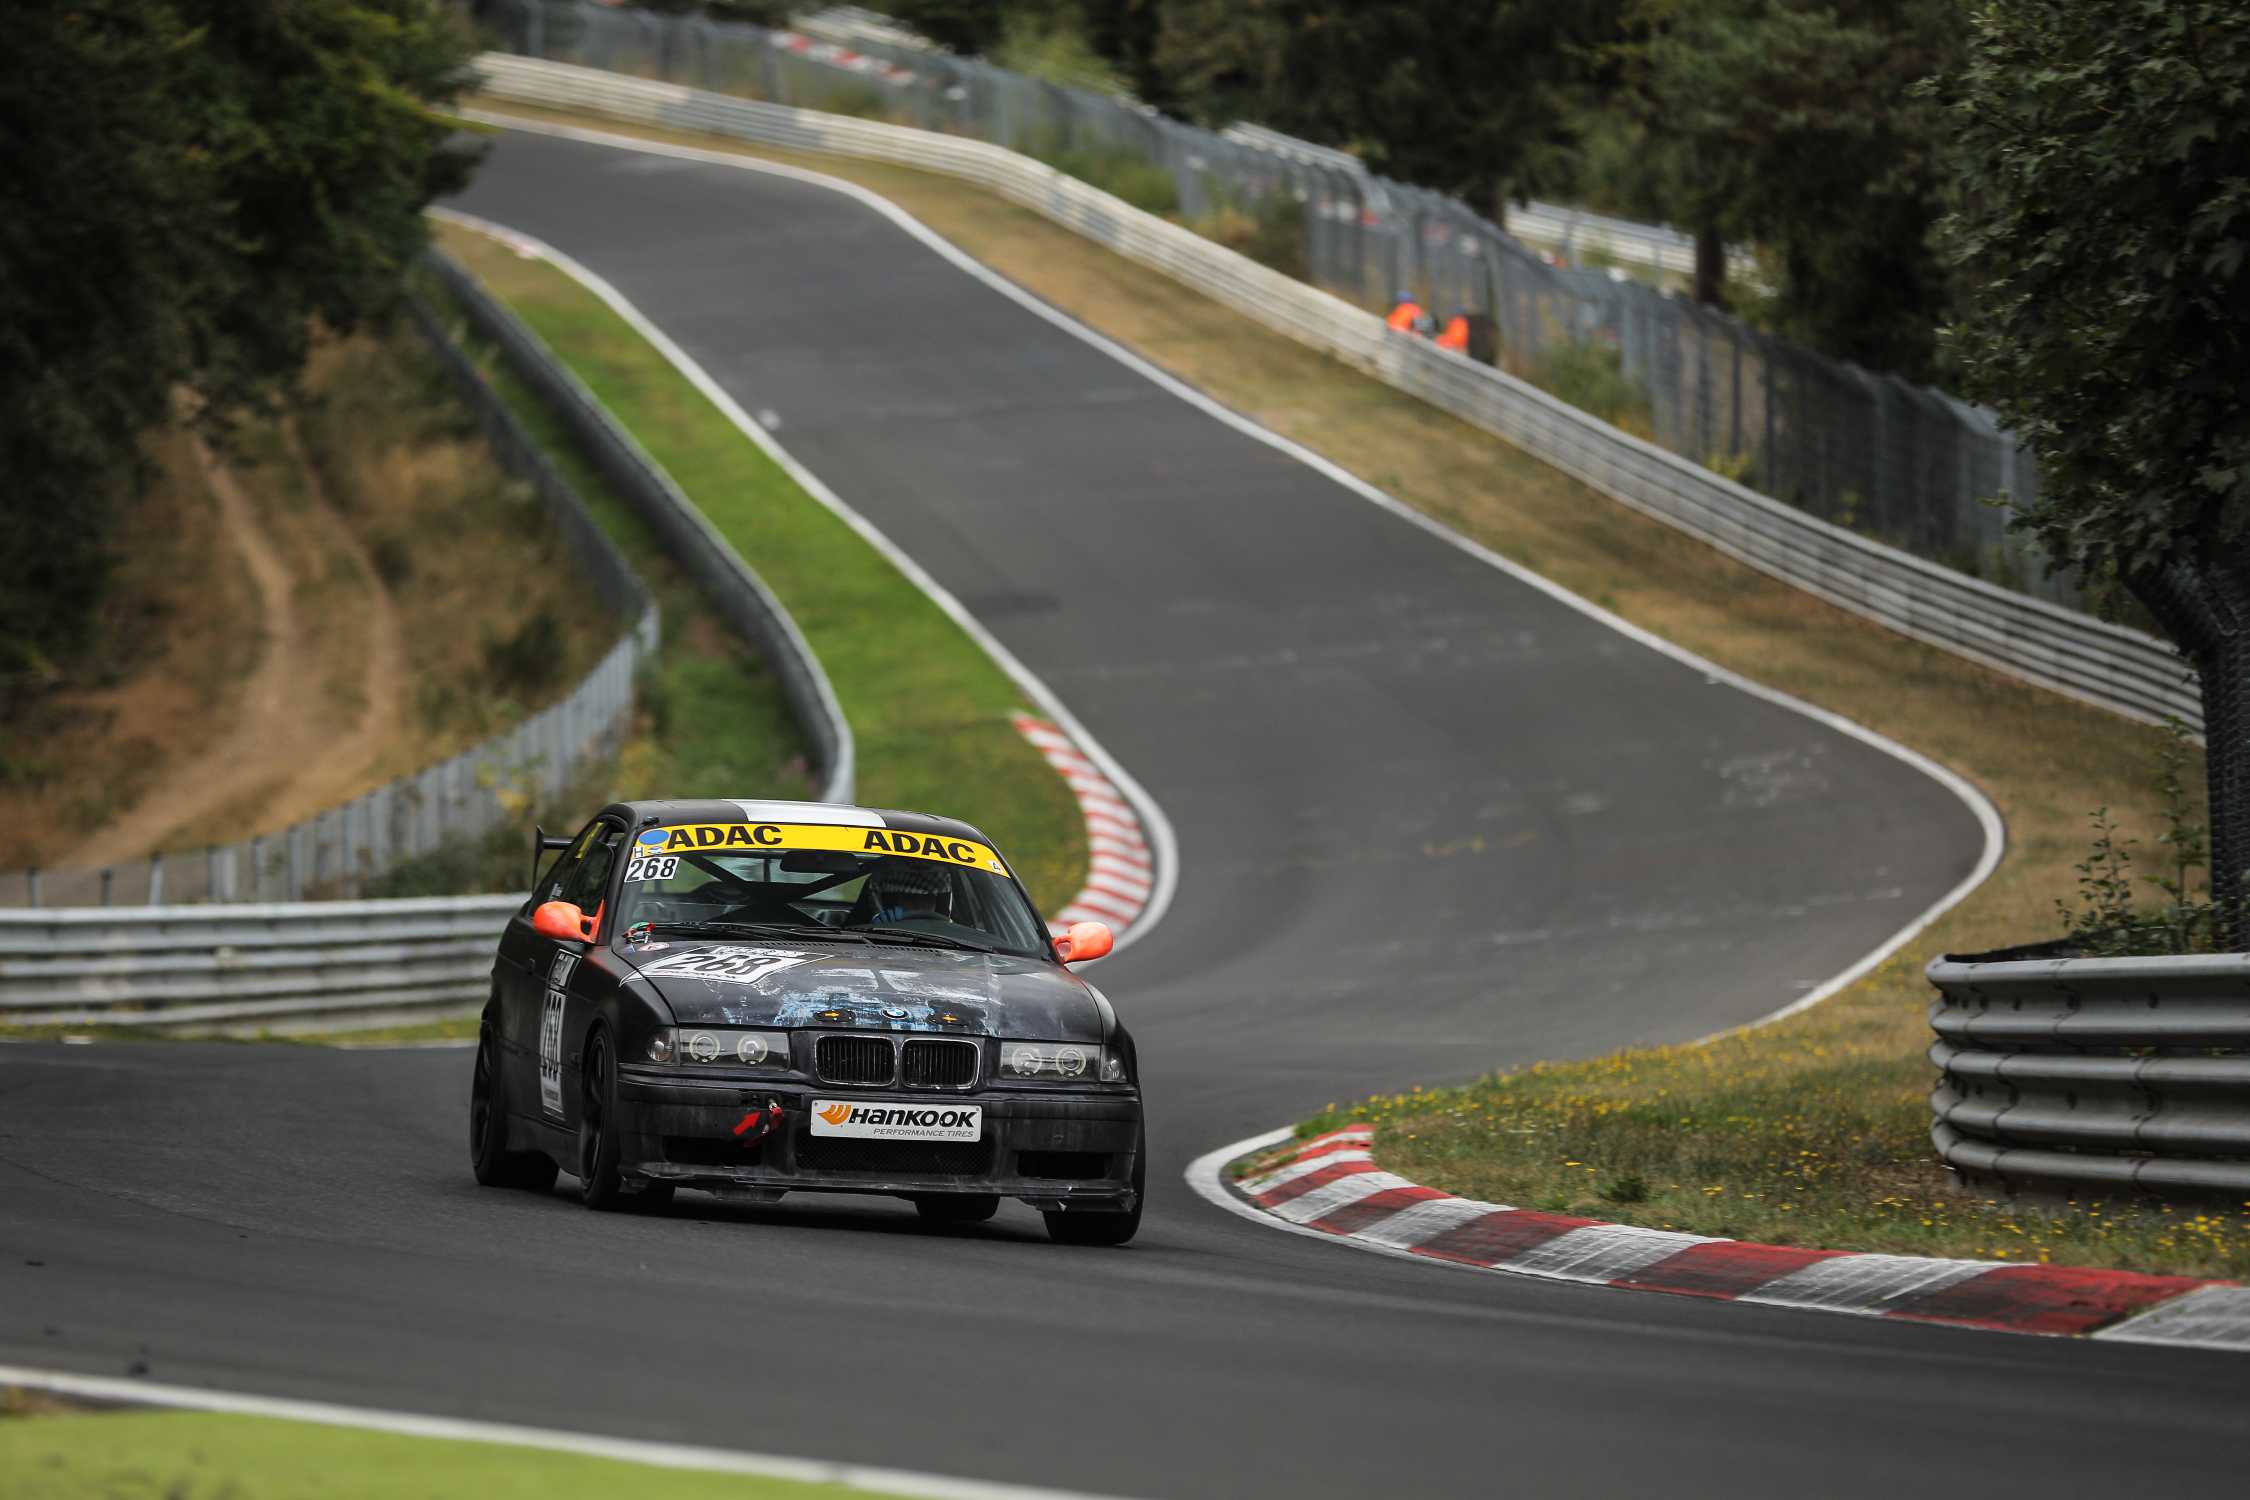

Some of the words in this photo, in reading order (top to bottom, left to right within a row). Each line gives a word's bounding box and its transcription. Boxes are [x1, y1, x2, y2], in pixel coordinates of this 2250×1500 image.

[666, 825, 783, 850] ADAC
[863, 830, 976, 864] ADAC
[625, 857, 677, 882] 268
[654, 954, 782, 975] 268
[873, 1128, 944, 1137] PERFORMANCE
[945, 1130, 974, 1138] TIRES
